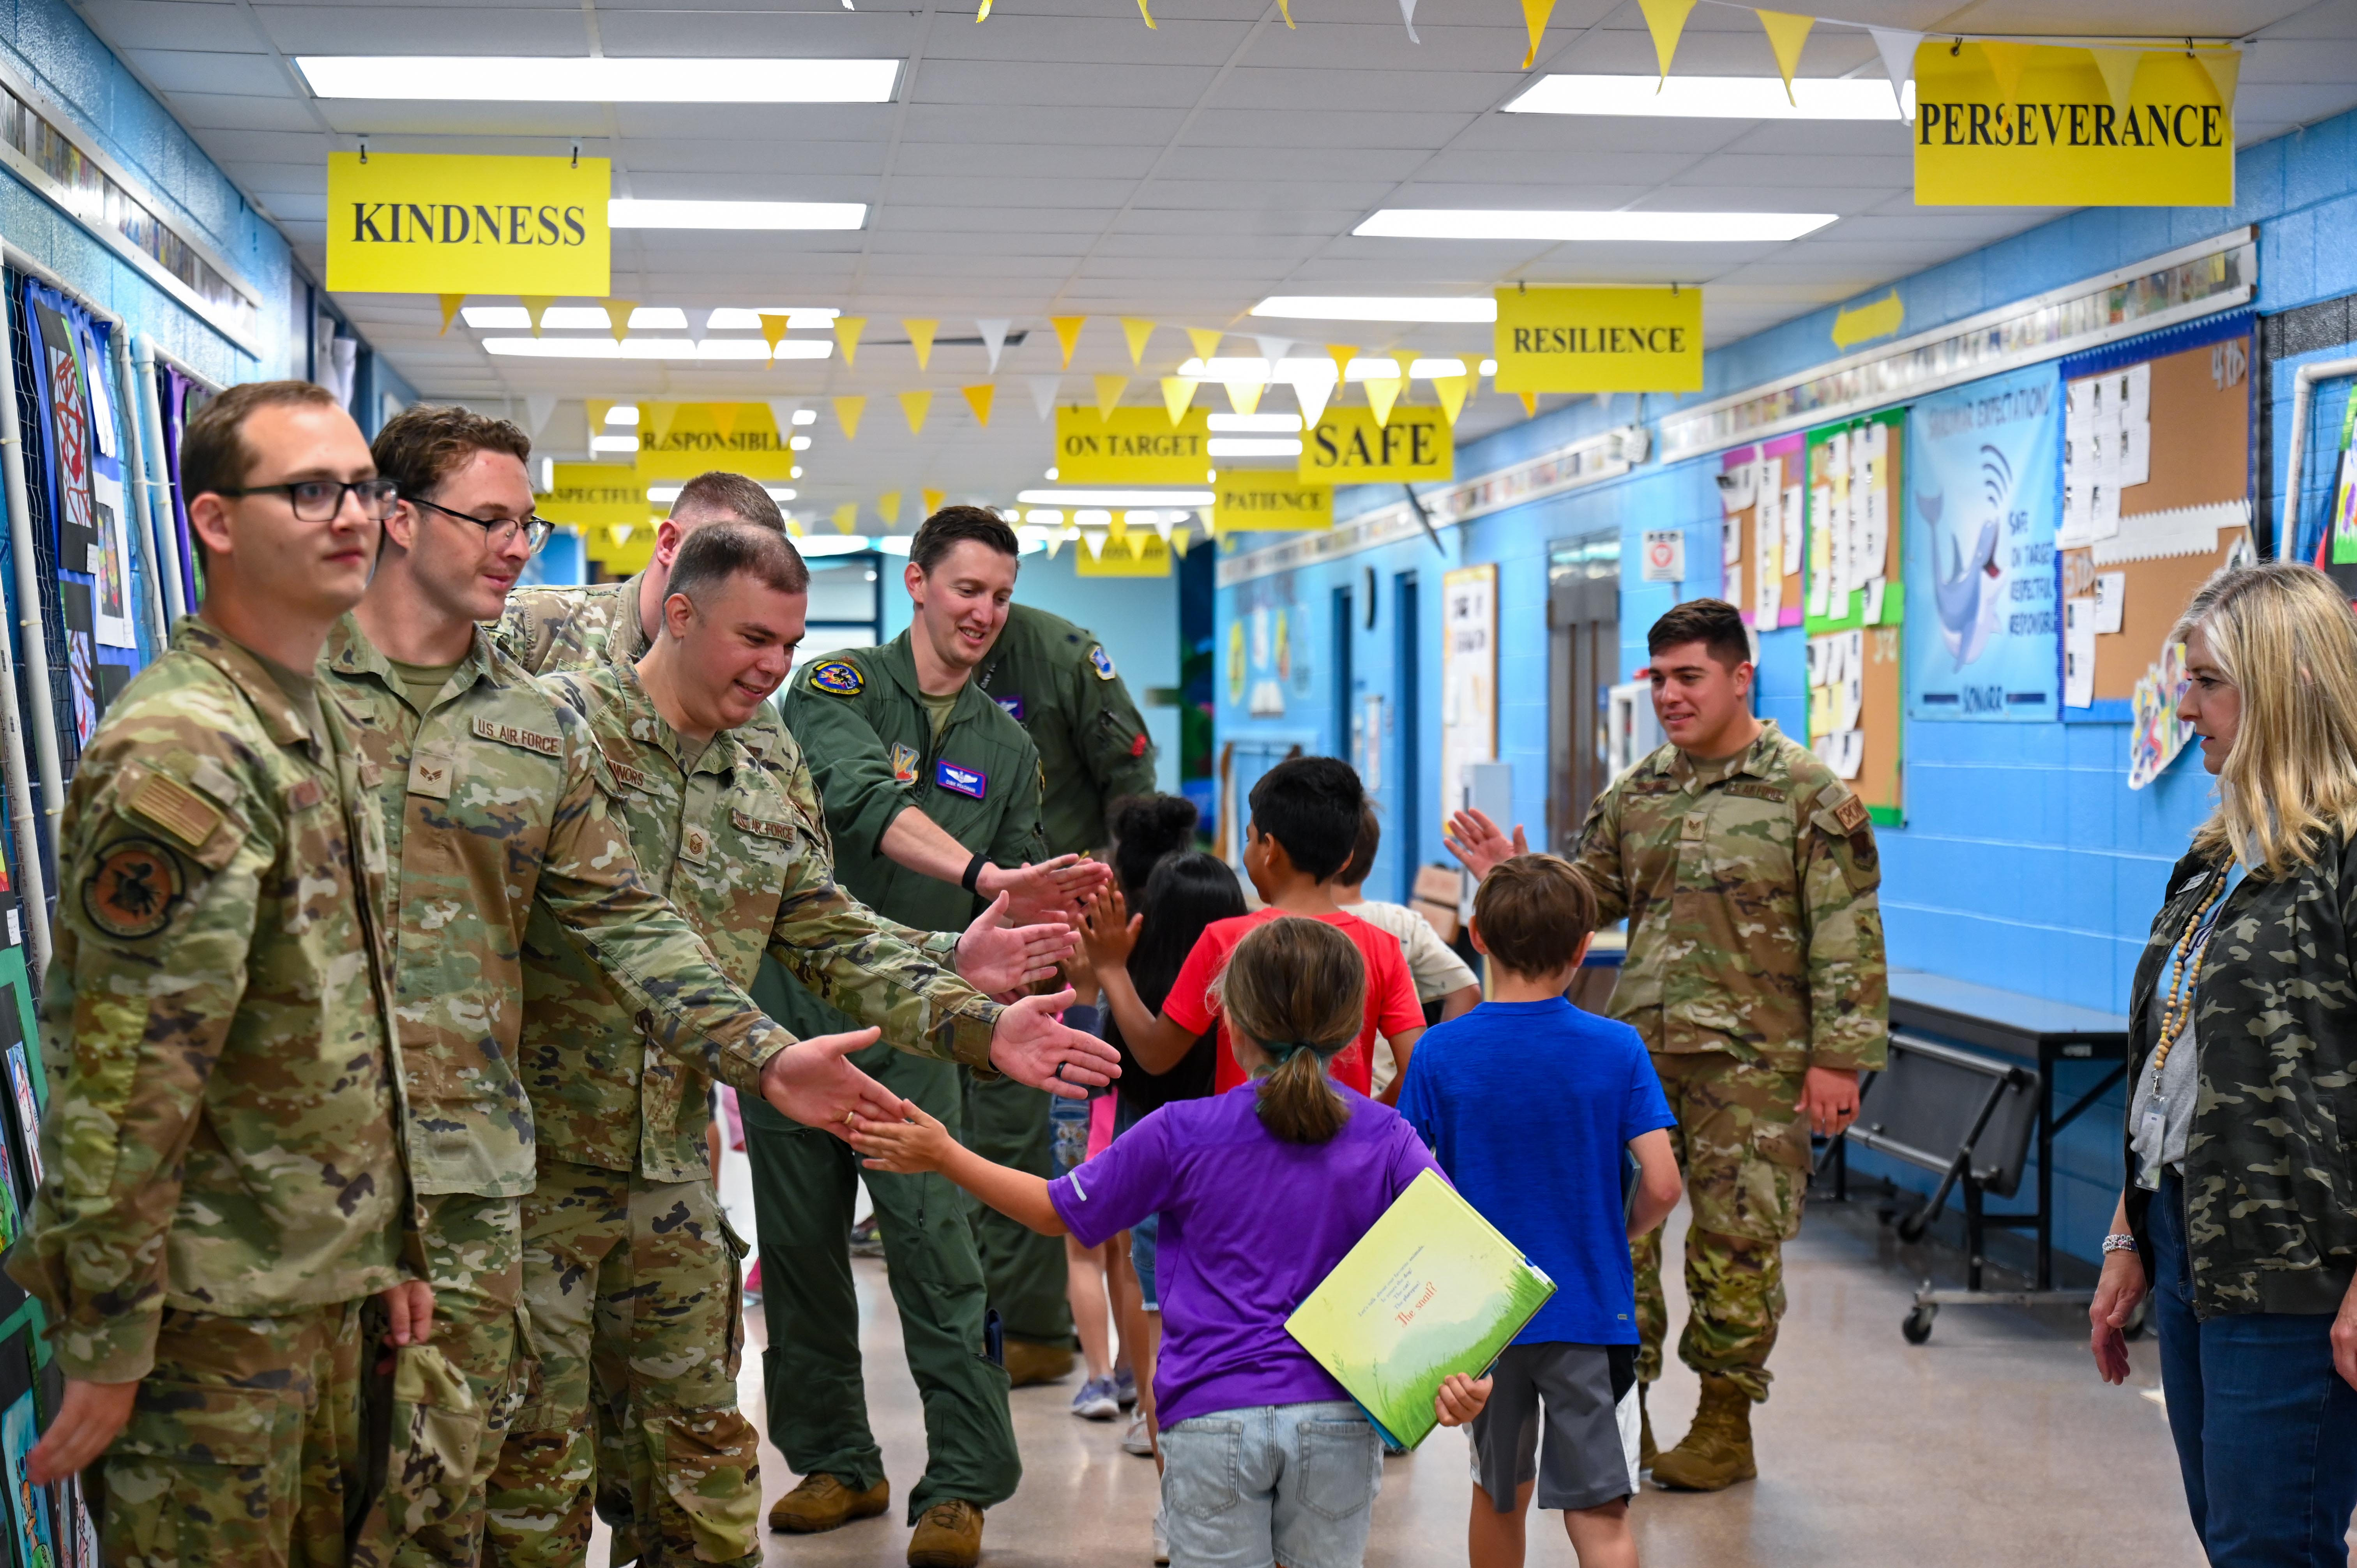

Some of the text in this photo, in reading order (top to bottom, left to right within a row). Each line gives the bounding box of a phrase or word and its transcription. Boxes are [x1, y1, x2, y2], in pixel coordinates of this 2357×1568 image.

[1919, 103, 2223, 147] PERSEVERANCE
[351, 203, 585, 246] KINDNESS
[1513, 328, 1685, 353] RESILIENCE
[1066, 435, 1200, 457] ON TARGET
[1315, 423, 1439, 467] SAFE
[1224, 492, 1324, 511] PATIENCE
[500, 726, 518, 743] AIR
[521, 731, 558, 753] FORCE
[765, 823, 793, 840] FORCE
[1395, 1281, 1437, 1328] The snail?
